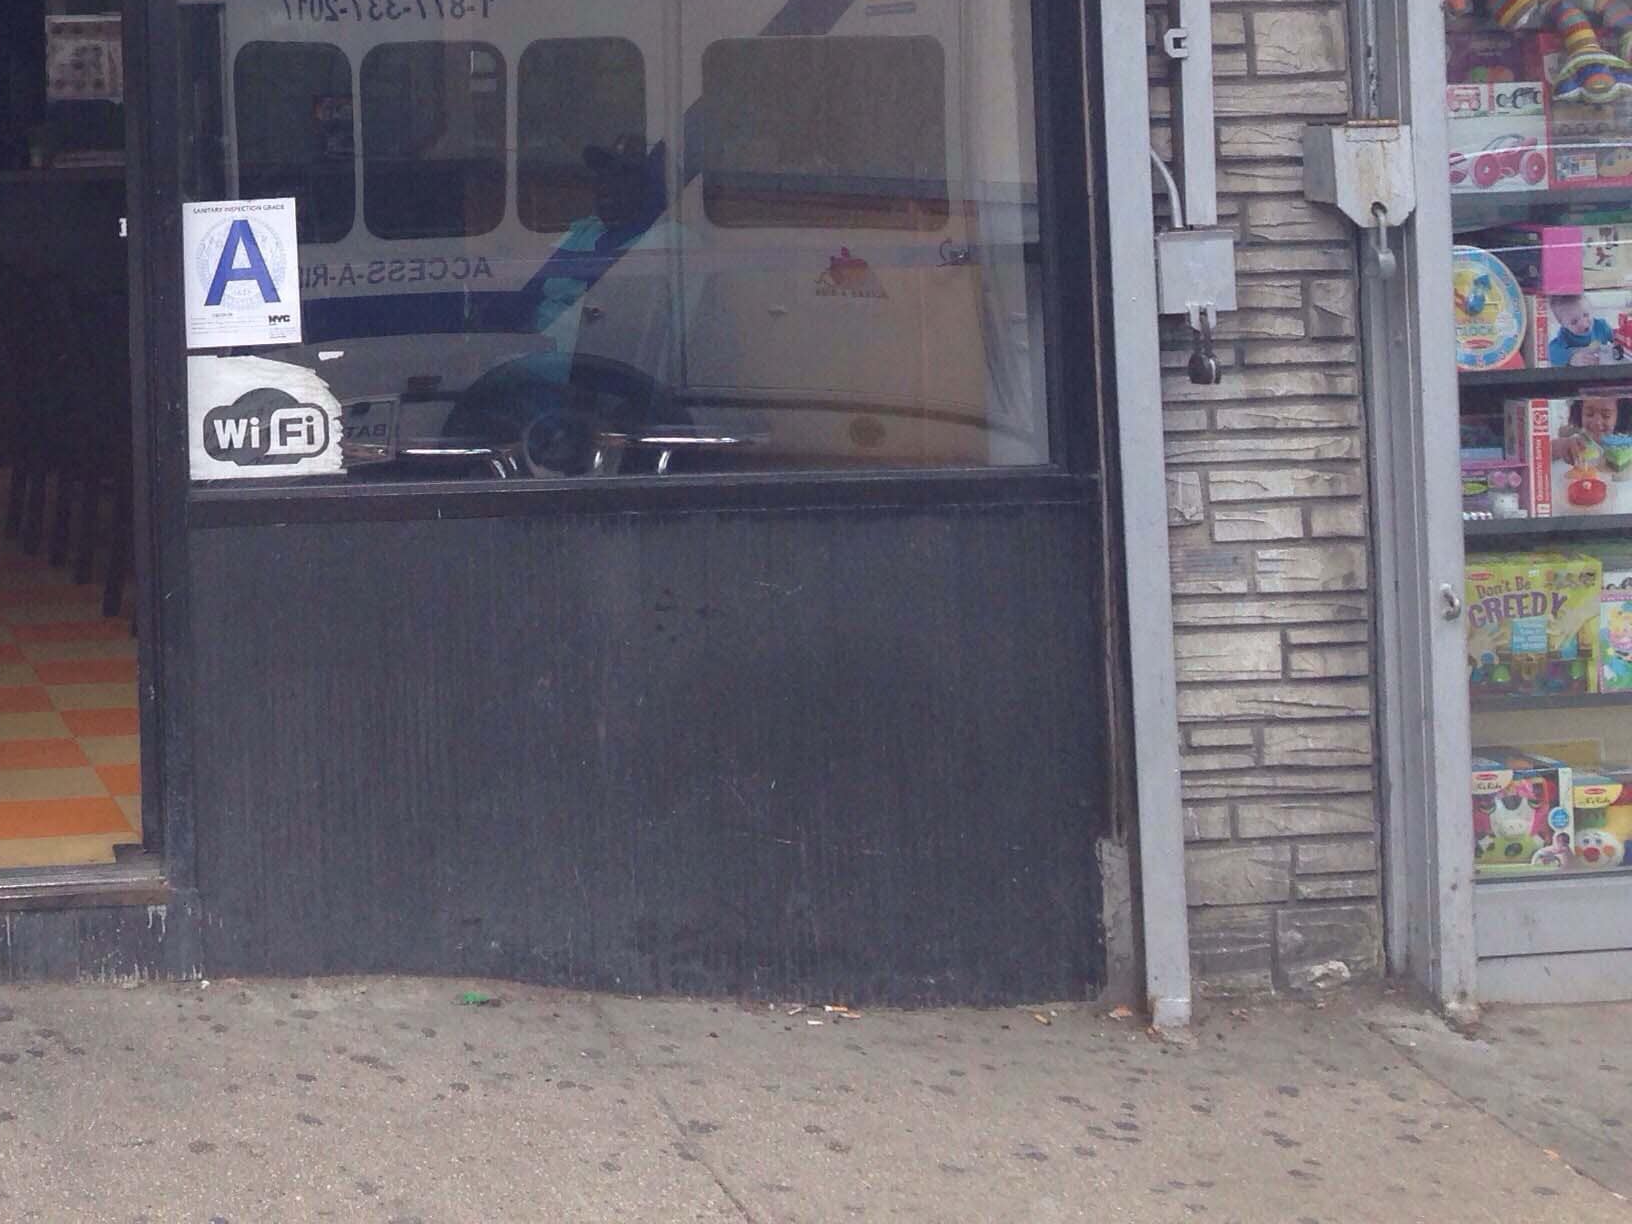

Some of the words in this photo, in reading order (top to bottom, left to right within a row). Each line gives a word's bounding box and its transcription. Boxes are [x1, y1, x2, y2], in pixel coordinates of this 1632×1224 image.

[204, 219, 282, 307] A
[268, 314, 291, 323] NYC
[1474, 579, 1512, 600] Don't
[1515, 576, 1532, 591] Be
[1468, 591, 1569, 629] GREEDY
